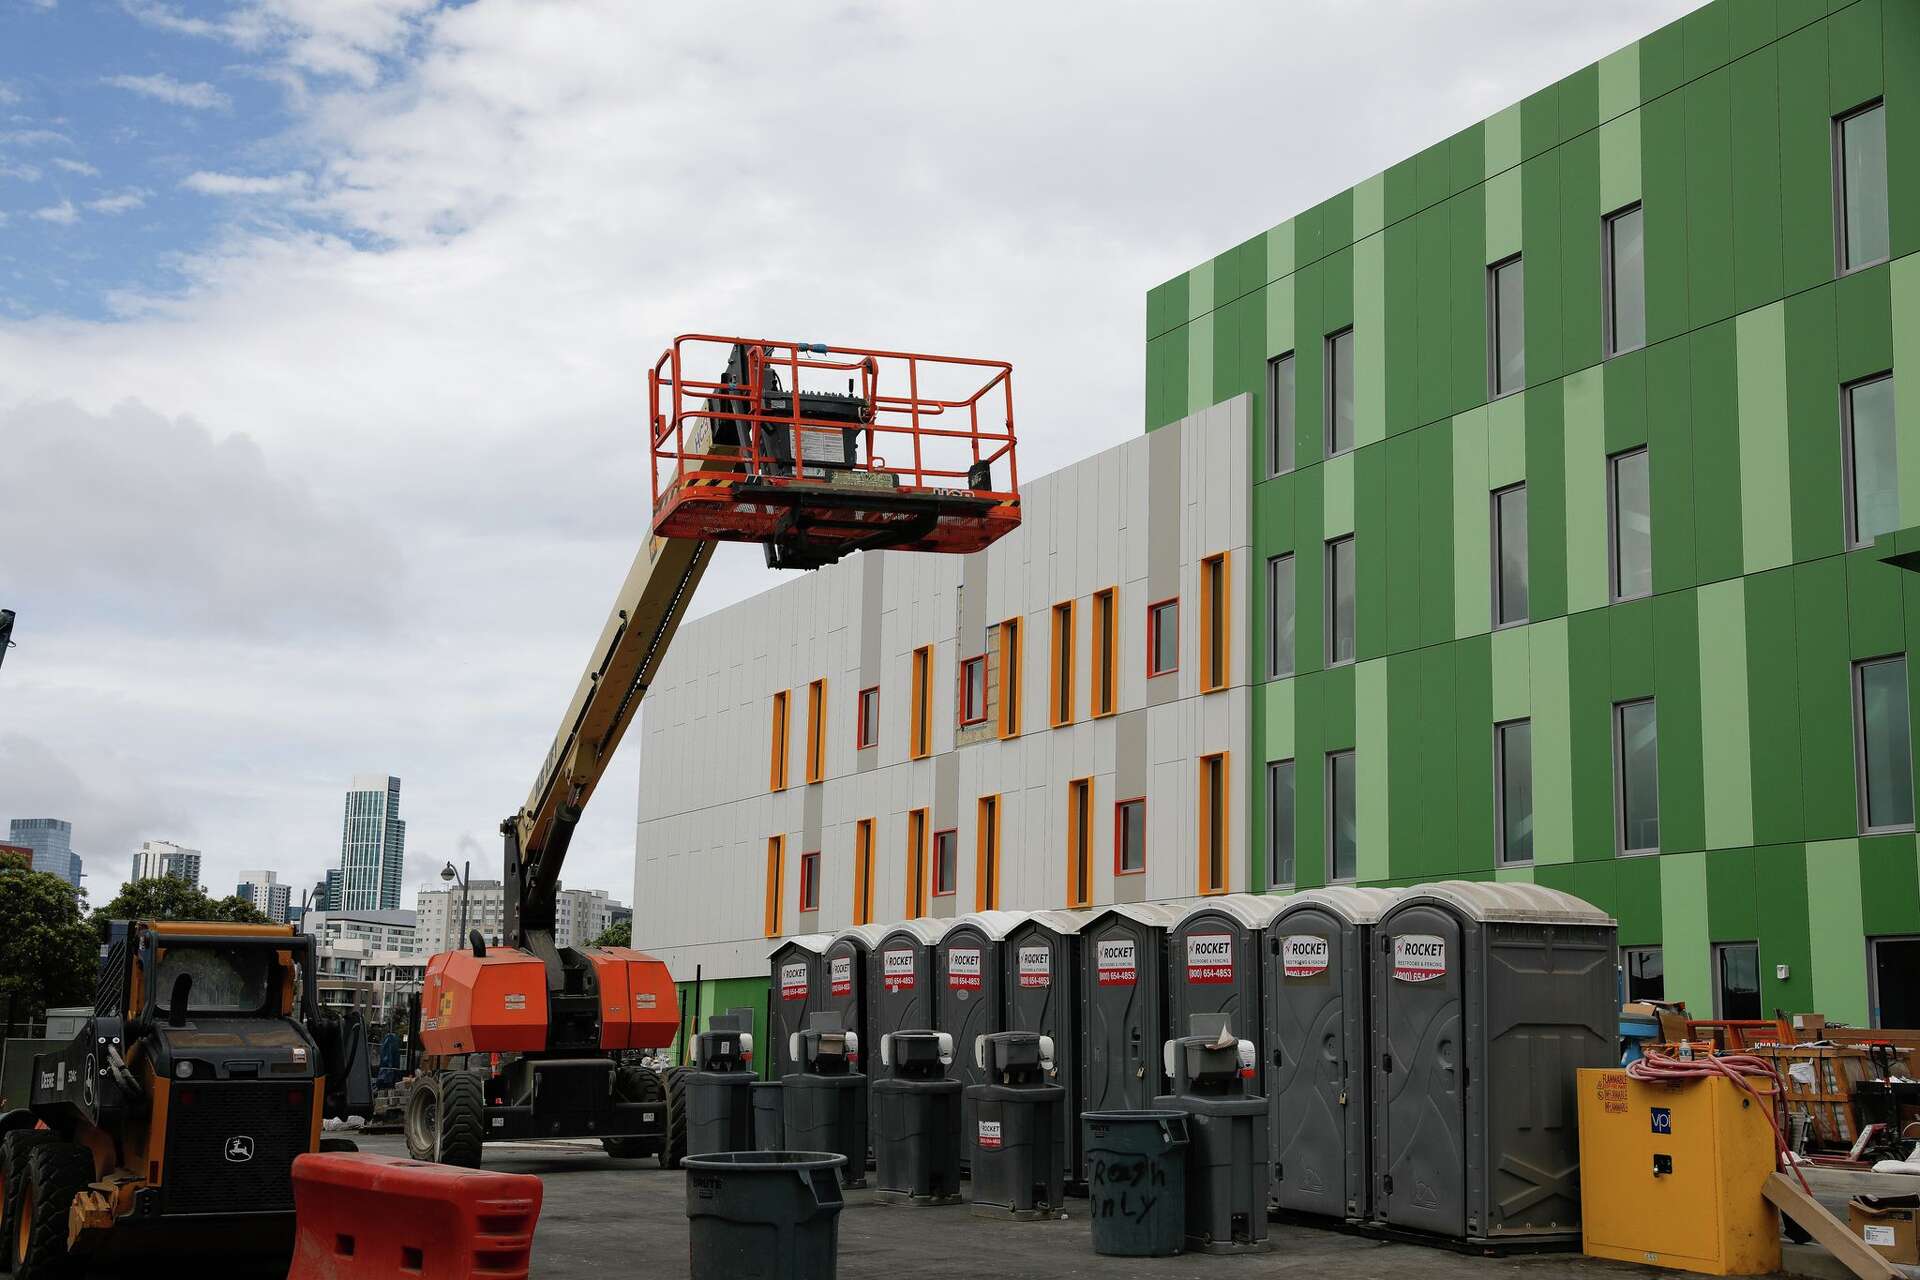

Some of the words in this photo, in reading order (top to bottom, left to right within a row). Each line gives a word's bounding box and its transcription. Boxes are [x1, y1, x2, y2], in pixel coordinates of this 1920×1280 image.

[1103, 947, 1134, 958] ROCKET
[1195, 942, 1230, 954] ROCKET
[1292, 942, 1327, 956] ROCKET
[1404, 942, 1444, 957] ROCKET
[889, 956, 913, 966] ROCKET
[955, 955, 979, 966] ROCKET
[1024, 953, 1048, 964] ROCKET
[786, 968, 806, 979] ROCKET
[834, 963, 850, 974] ROCKET
[1203, 969, 1232, 978] 654-4853
[893, 976, 914, 985] 654-4853
[1110, 971, 1136, 981] 654-4853
